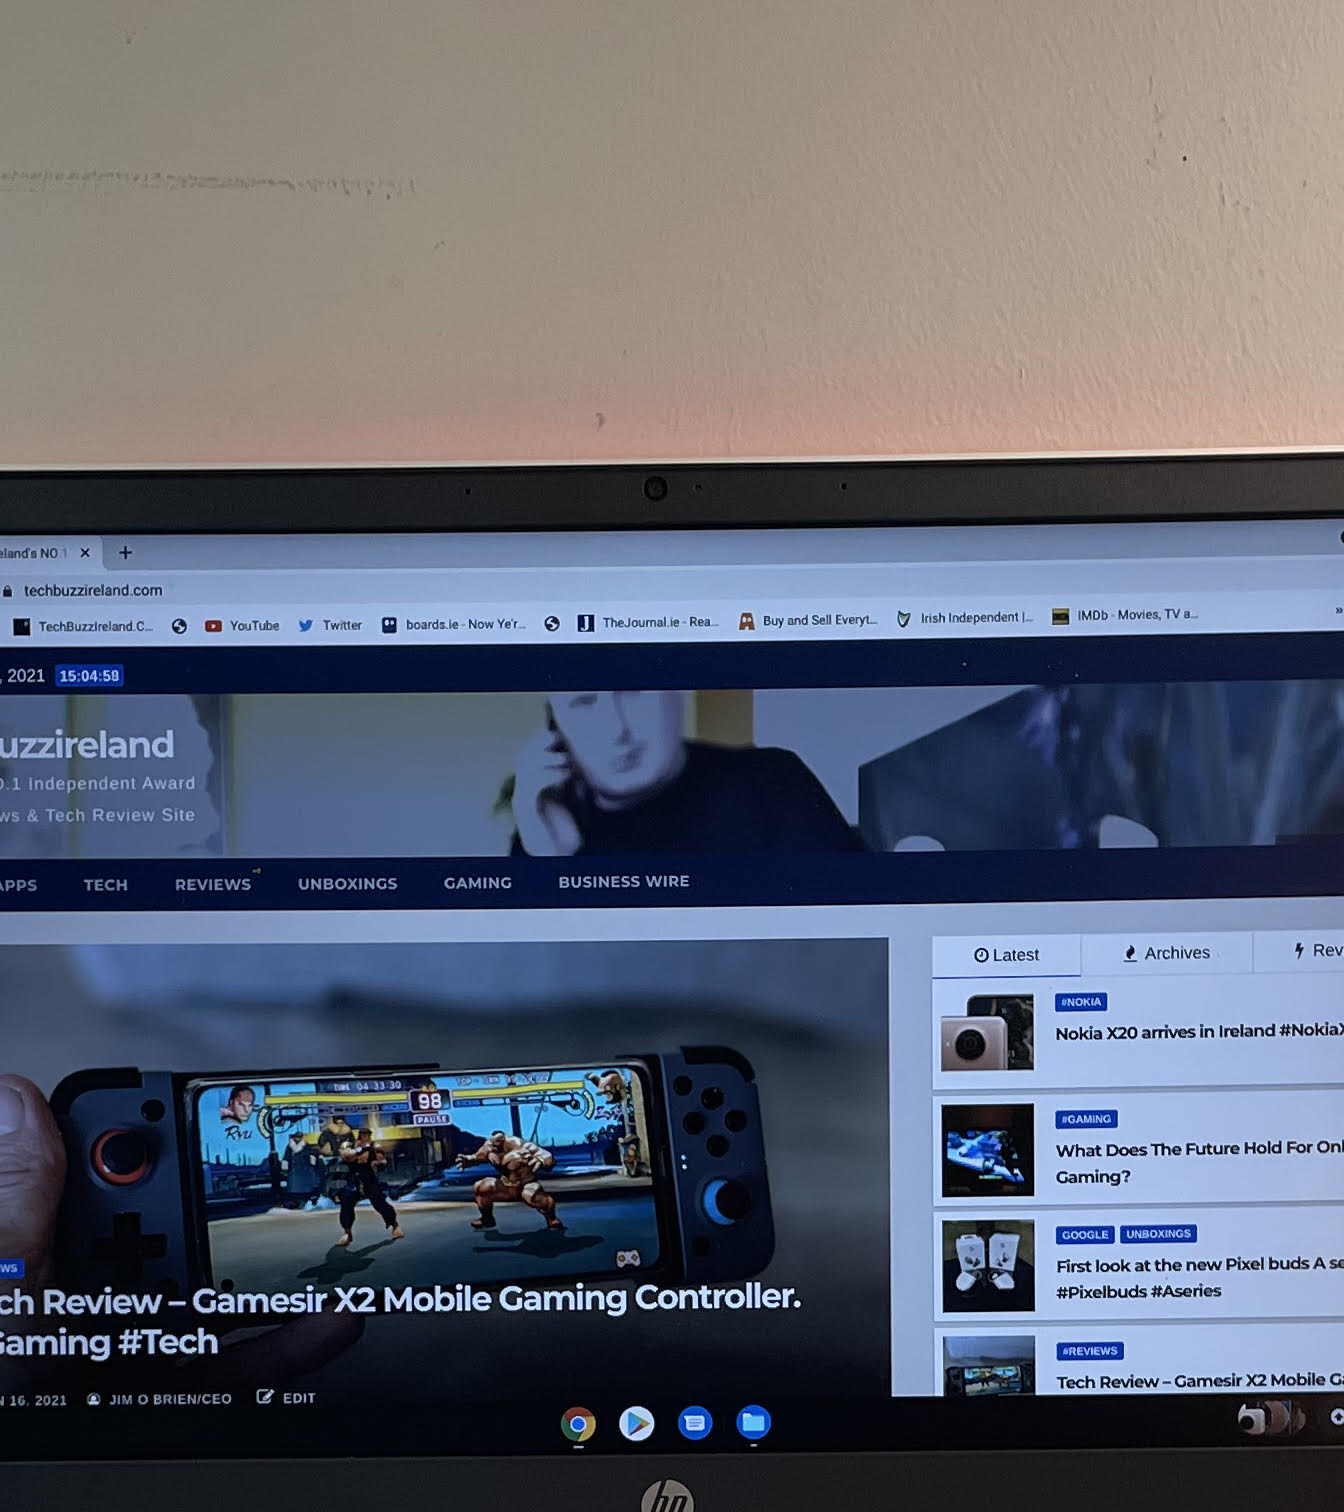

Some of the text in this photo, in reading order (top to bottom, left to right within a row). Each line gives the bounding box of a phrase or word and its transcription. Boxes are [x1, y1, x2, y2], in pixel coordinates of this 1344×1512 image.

[24, 584, 163, 598] techbuzzireland.com
[763, 614, 832, 629] Buy and Sell
[921, 611, 1018, 626] Irish Independent
[1078, 608, 1181, 622] IMDb Movies, TV
[230, 620, 280, 631] YouTube
[323, 619, 362, 631] Twitter
[406, 618, 496, 631] boards.ie Now
[603, 617, 680, 629] TheJournal.ie
[8, 669, 45, 683] 2021
[29, 776, 136, 794] Independent
[142, 775, 195, 791] Award
[27, 808, 39, 823] &
[45, 808, 85, 823] Tech
[92, 807, 155, 822] Review
[162, 807, 195, 822] Site
[84, 879, 128, 892] TECH
[175, 878, 251, 892] REVIEWS
[298, 877, 398, 891] UNBOXINGS
[444, 877, 512, 890] GAMING
[559, 876, 640, 889] BUSINESS
[646, 875, 690, 888] WIRE
[993, 947, 1039, 963] Latest
[1145, 945, 1210, 961] Archives
[1061, 997, 1102, 1008] #NOKIA
[1056, 1026, 1102, 1041] Nokia
[1107, 1026, 1137, 1040] X20
[1141, 1024, 1196, 1039] arrives
[1200, 1024, 1214, 1038] in
[1219, 1023, 1275, 1038] Ireland
[418, 1093, 441, 1109] 98
[417, 1115, 447, 1124] PAUSE
[1061, 1114, 1111, 1125] #GAMING
[1056, 1143, 1102, 1158] What
[1106, 1142, 1147, 1157] Does
[1151, 1142, 1182, 1157] The
[1186, 1142, 1240, 1157] Future
[1244, 1140, 1283, 1156] Hold
[1287, 1140, 1314, 1155] For
[1056, 1169, 1131, 1187] Gaming?
[1062, 1230, 1109, 1240] GOOGLE
[1126, 1228, 1191, 1239] UNBOXINGS
[1057, 1258, 1092, 1273] First
[1096, 1258, 1131, 1273] look
[1135, 1259, 1151, 1272] at
[1154, 1257, 1182, 1272] the
[1186, 1259, 1222, 1272] new
[1226, 1256, 1264, 1271] Pixel
[1268, 1255, 1309, 1271] buds
[1314, 1256, 1326, 1270] A
[1057, 1283, 1222, 1300] #Pixelbuds #Aseries
[44, 1286, 162, 1315] Review
[193, 1284, 327, 1314] Gamesir
[334, 1287, 376, 1314] X2
[384, 1285, 492, 1313] Mobile
[499, 1283, 627, 1317] Gaming
[635, 1281, 802, 1311] Controller.
[118, 1327, 218, 1356] #Tech
[1062, 1345, 1118, 1357] #REVIEWS
[1057, 1375, 1096, 1390] Tech
[1100, 1374, 1159, 1389] Review
[1174, 1373, 1242, 1388] Gamesir
[1247, 1373, 1267, 1387] X2
[1271, 1372, 1325, 1387] Mobile
[35, 1395, 67, 1406] 2021
[109, 1393, 232, 1406] JIM O BRIEN/CEO
[283, 1392, 316, 1404] EDIT
